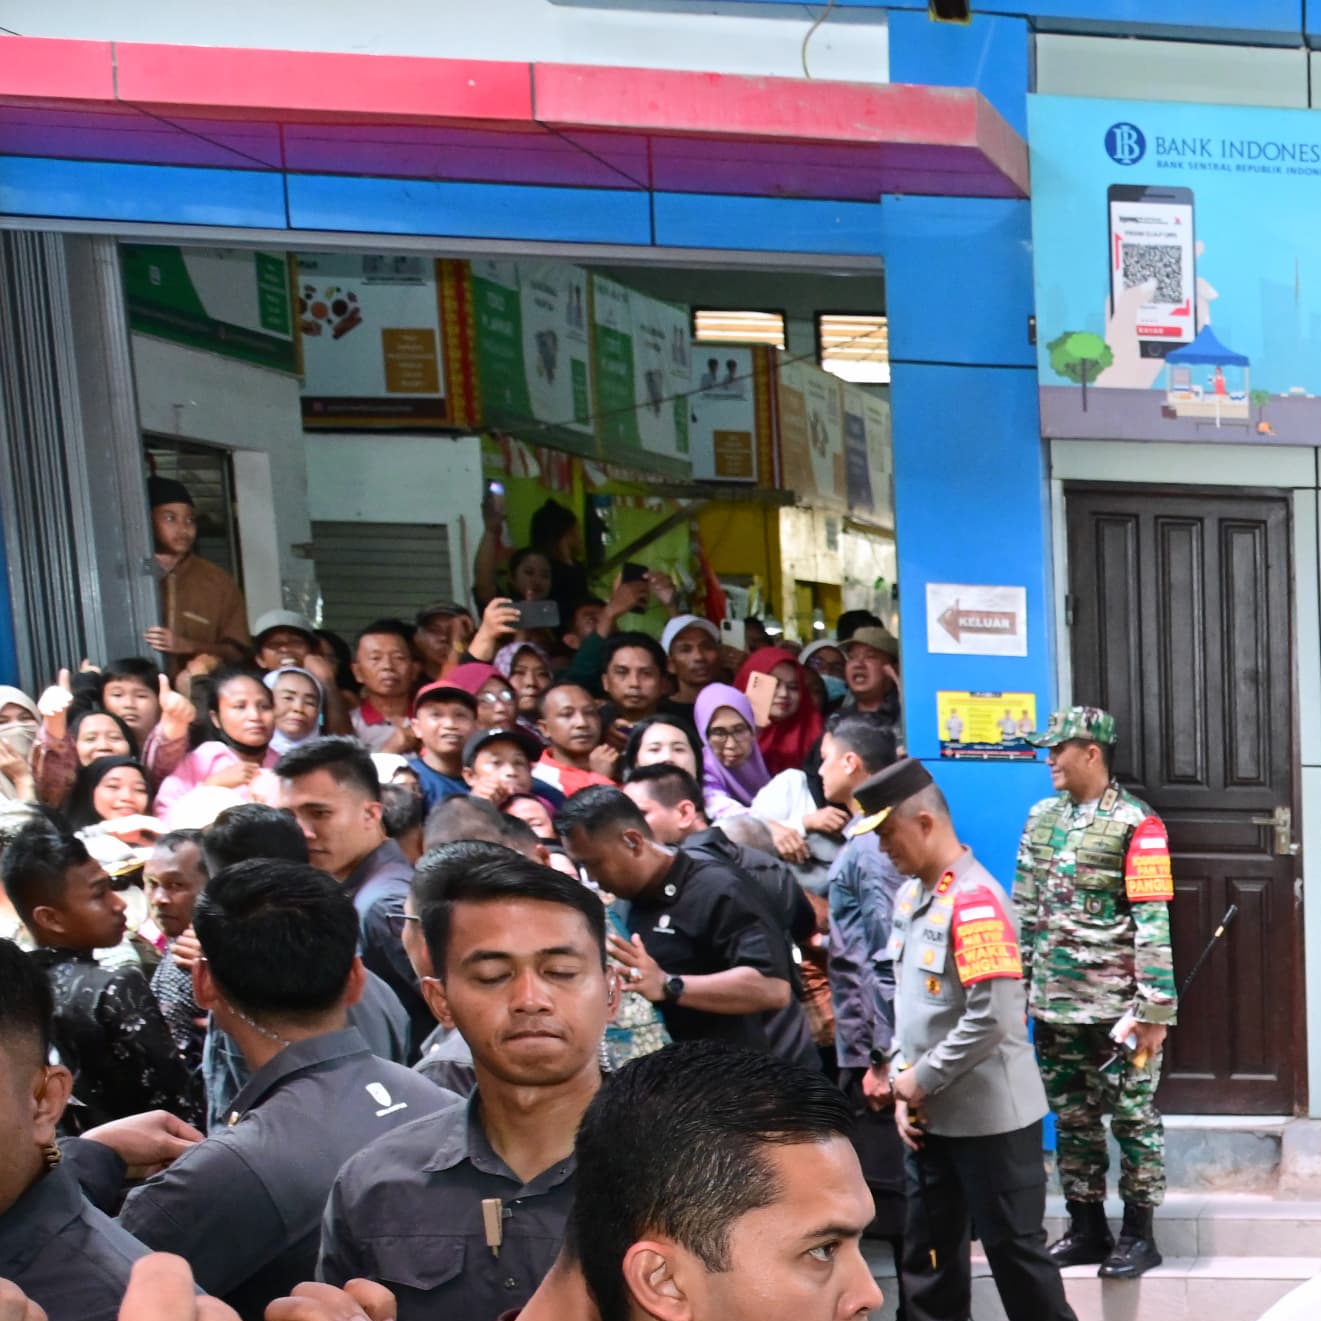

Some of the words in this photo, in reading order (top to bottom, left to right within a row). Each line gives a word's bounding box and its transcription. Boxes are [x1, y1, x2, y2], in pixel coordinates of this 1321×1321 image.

[1155, 136, 1213, 158] BANK
[1156, 160, 1184, 169] BANK
[1235, 163, 1282, 174] REPUBLIK
[958, 616, 1011, 630] KELUAR
[923, 928, 944, 942] POLRI
[963, 945, 1009, 963] WAKIL
